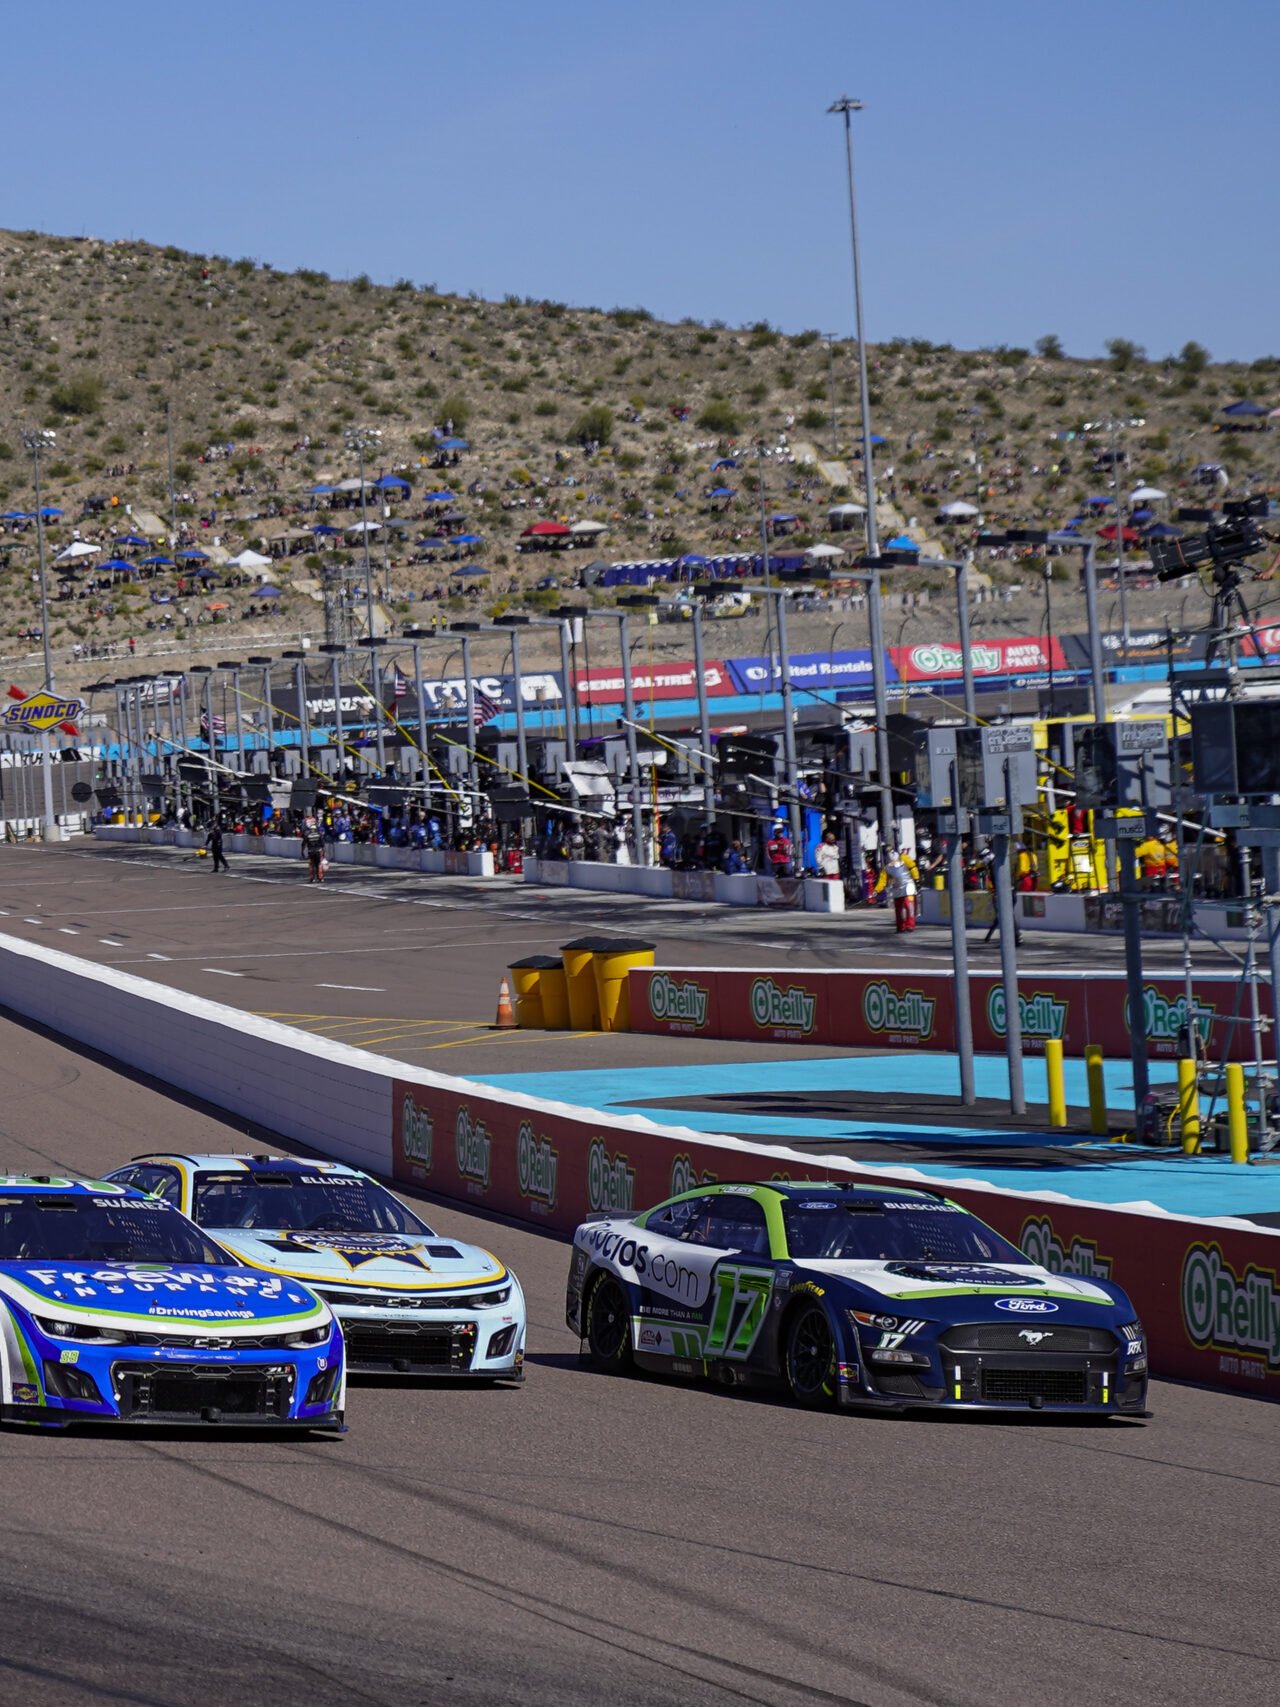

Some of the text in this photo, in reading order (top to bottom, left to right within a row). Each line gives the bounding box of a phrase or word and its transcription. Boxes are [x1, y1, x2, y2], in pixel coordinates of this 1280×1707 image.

[914, 645, 1000, 672] O'Relly
[1006, 645, 1040, 657] AUTO
[819, 660, 873, 675] Rentals
[577, 671, 693, 693] GENEAL TIRE
[9, 702, 77, 721] SUNOCO
[1119, 825, 1144, 835] musco
[650, 974, 707, 1027] O'Reilly
[751, 978, 816, 1033] O'Reilly
[864, 982, 935, 1039] O'Reilly
[404, 1095, 433, 1175] O'Reilly
[457, 1107, 490, 1190] O'Reilly
[519, 1121, 558, 1211] O'Reilly
[301, 1176, 364, 1187] ELLIOTT
[92, 1198, 169, 1211] SUÁREZ
[883, 1202, 960, 1213] BUESCHER
[26, 1268, 283, 1294] Freeway
[148, 1306, 255, 1319] #DrivingSavings
[652, 1306, 669, 1316] MORE
[670, 1309, 686, 1319] THAN
[704, 1265, 775, 1360] 17
[1008, 1299, 1047, 1312] Ford
[1183, 1244, 1280, 1365] O'Reilly
[878, 1332, 907, 1349] 17
[60, 1350, 79, 1364] 99
[1219, 1355, 1266, 1380] AUTO PARTS
